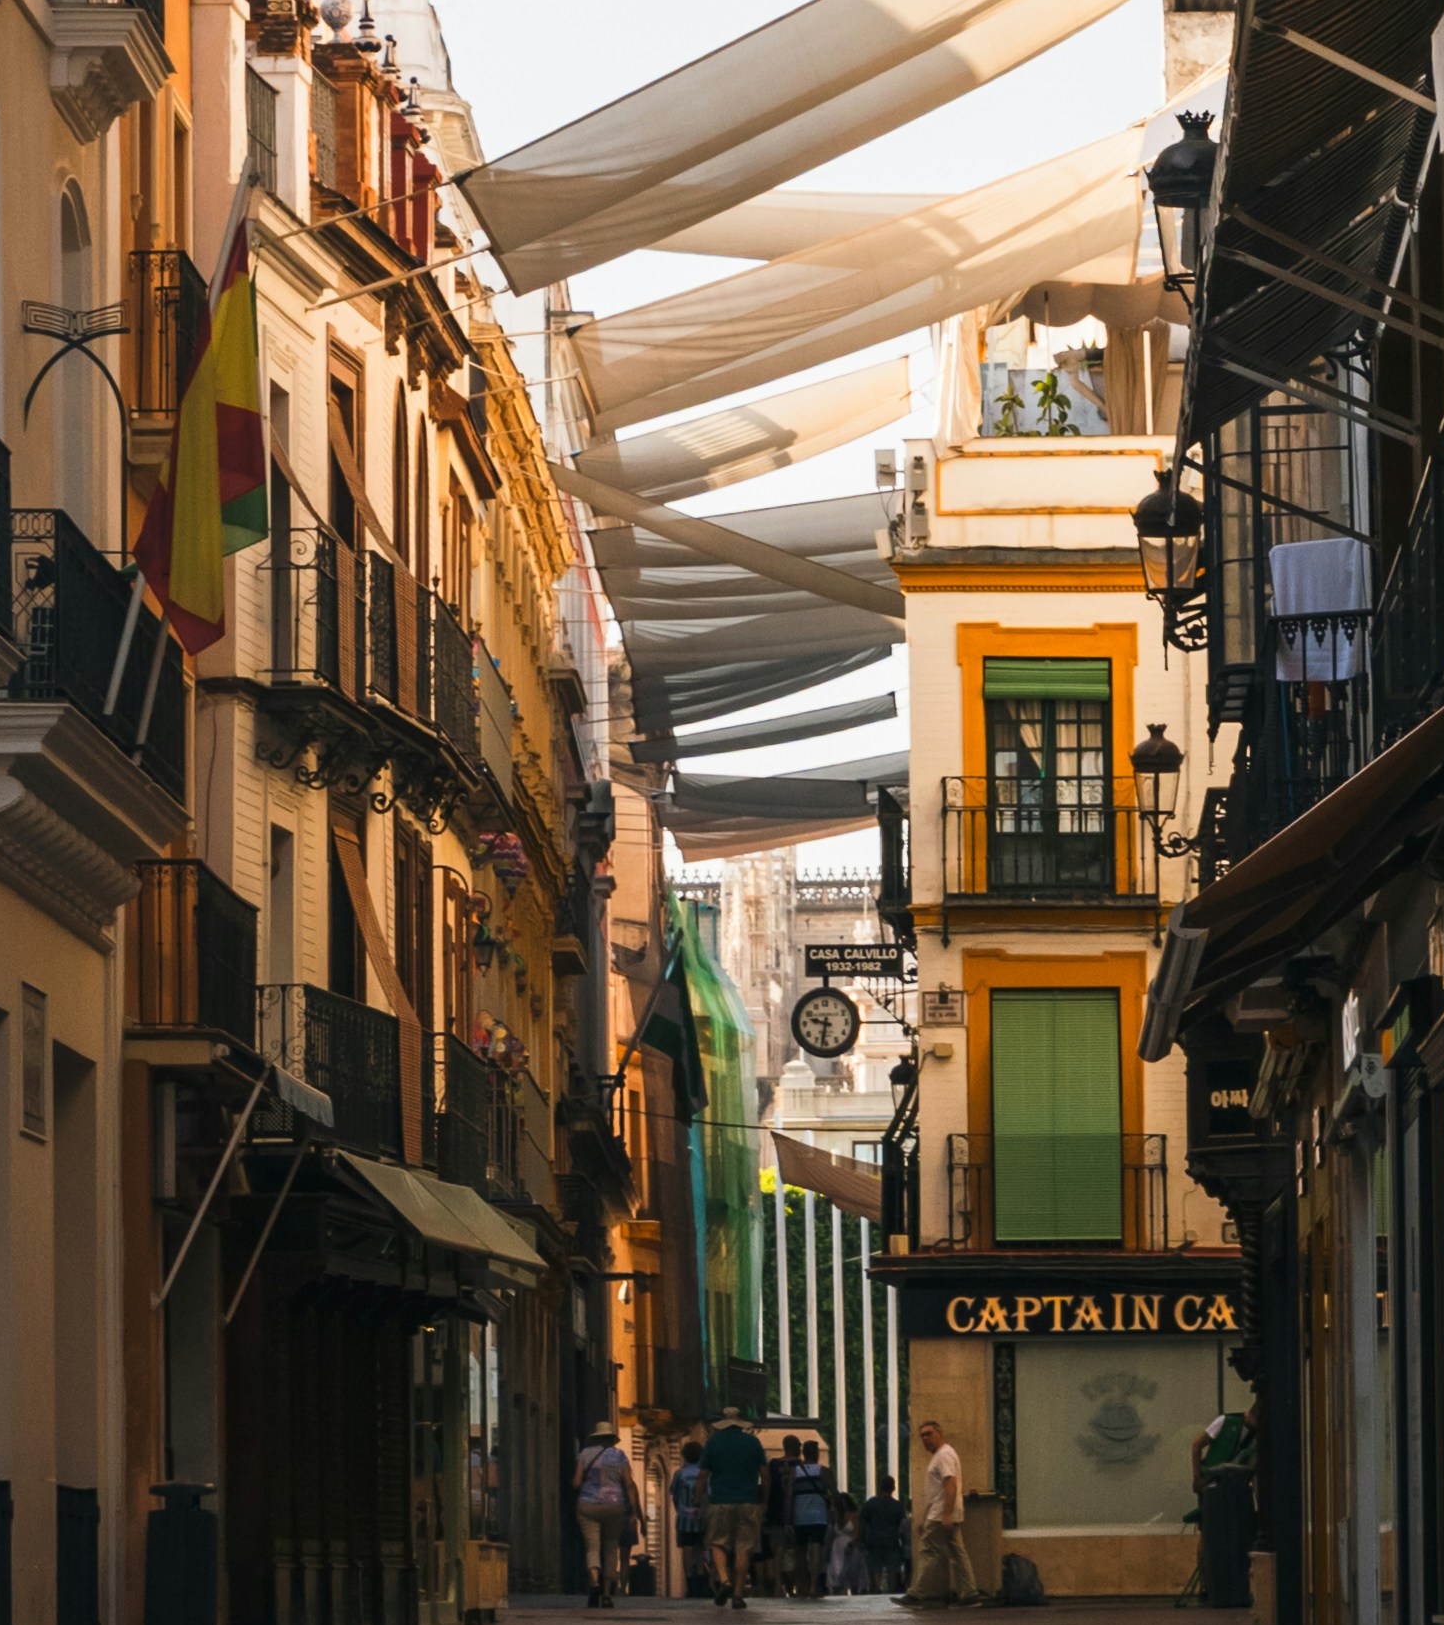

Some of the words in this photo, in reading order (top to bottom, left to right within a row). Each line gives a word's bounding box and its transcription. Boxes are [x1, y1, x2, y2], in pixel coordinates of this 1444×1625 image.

[809, 949, 840, 960] CASA
[844, 948, 898, 960] CALVILLO
[825, 961, 882, 971] 1932-1982
[946, 1293, 1164, 1333] CAPTAIN
